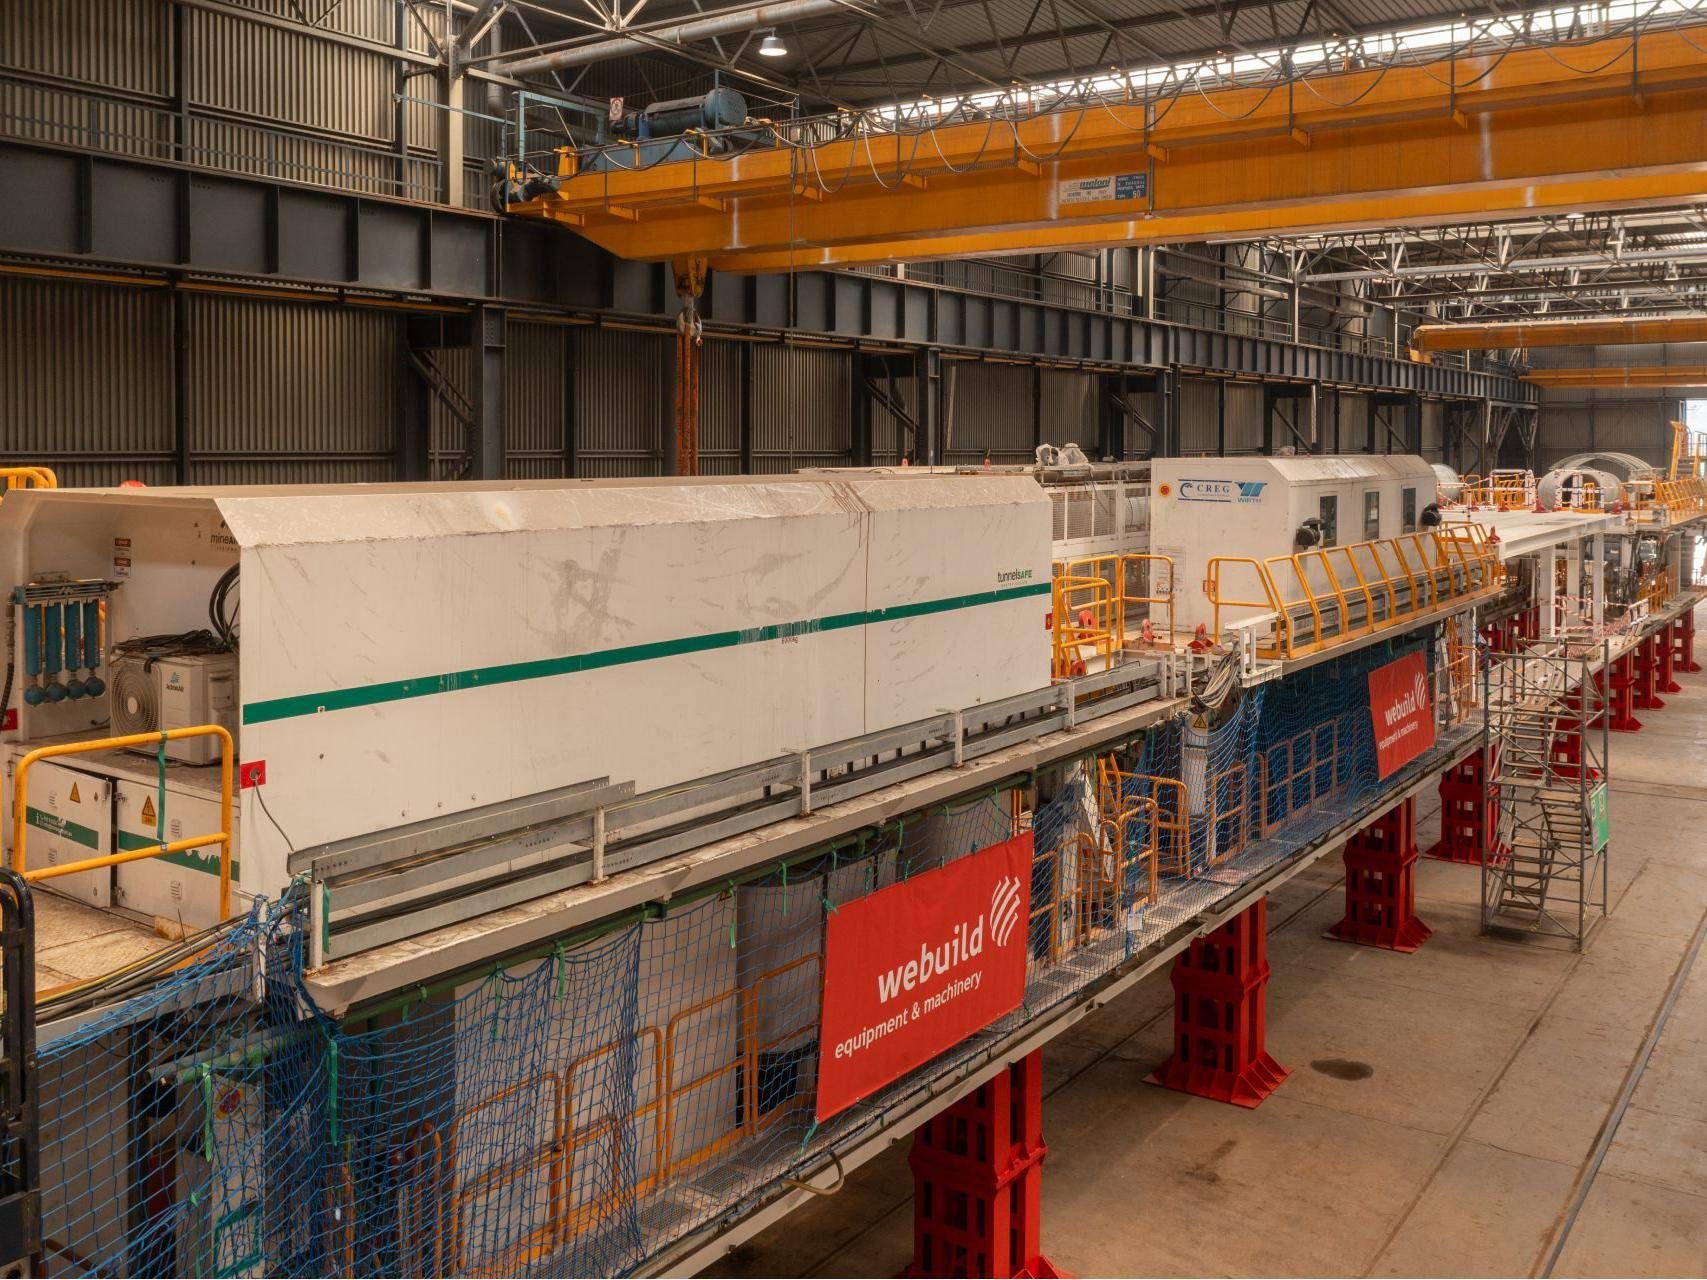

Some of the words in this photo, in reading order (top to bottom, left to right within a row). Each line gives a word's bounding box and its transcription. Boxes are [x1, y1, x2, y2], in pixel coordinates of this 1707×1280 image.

[1197, 484, 1230, 493] CREG
[1385, 690, 1416, 726] webuild
[878, 914, 983, 1003] webuild
[834, 1008, 908, 1059] equipment
[911, 1003, 920, 1020] &
[924, 970, 982, 1014] machinery
